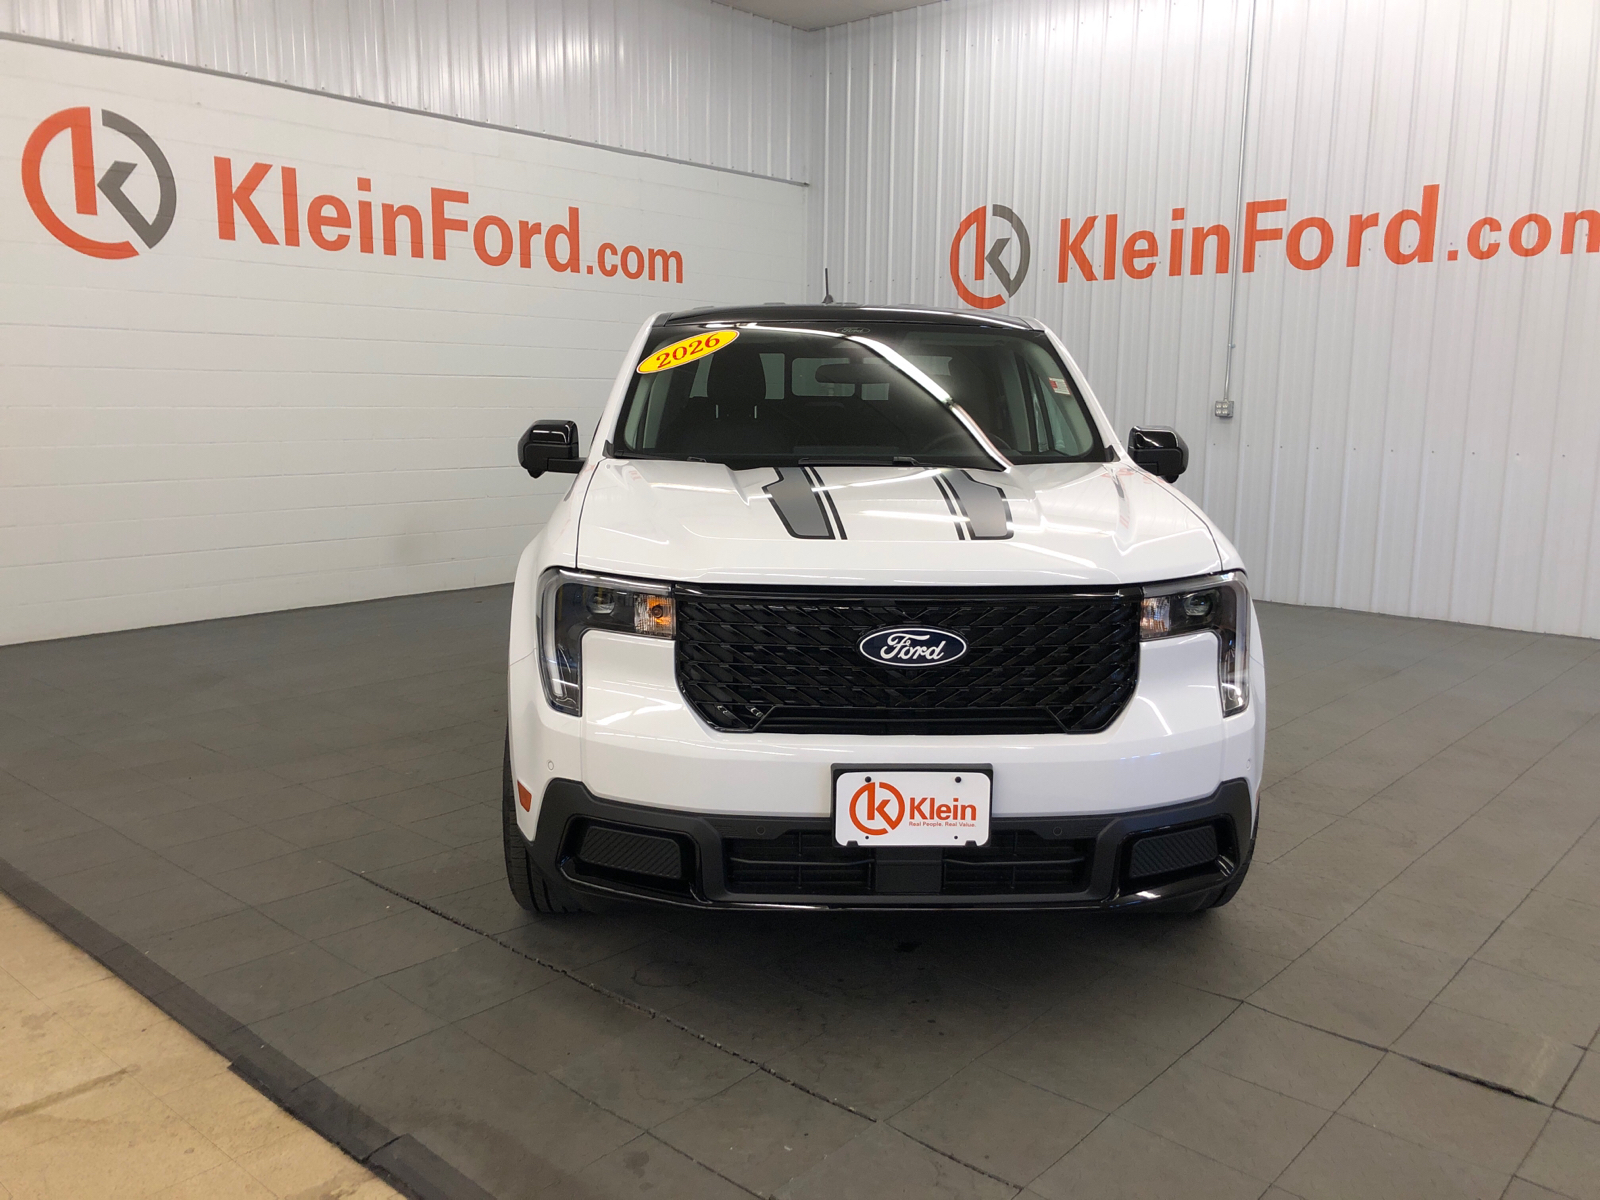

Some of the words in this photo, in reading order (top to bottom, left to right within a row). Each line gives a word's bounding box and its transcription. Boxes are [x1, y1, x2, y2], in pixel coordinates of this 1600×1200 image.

[213, 156, 684, 284] KleinFord.com
[656, 333, 720, 369] 2026
[880, 633, 946, 660] Ford
[909, 797, 977, 821] Klein
